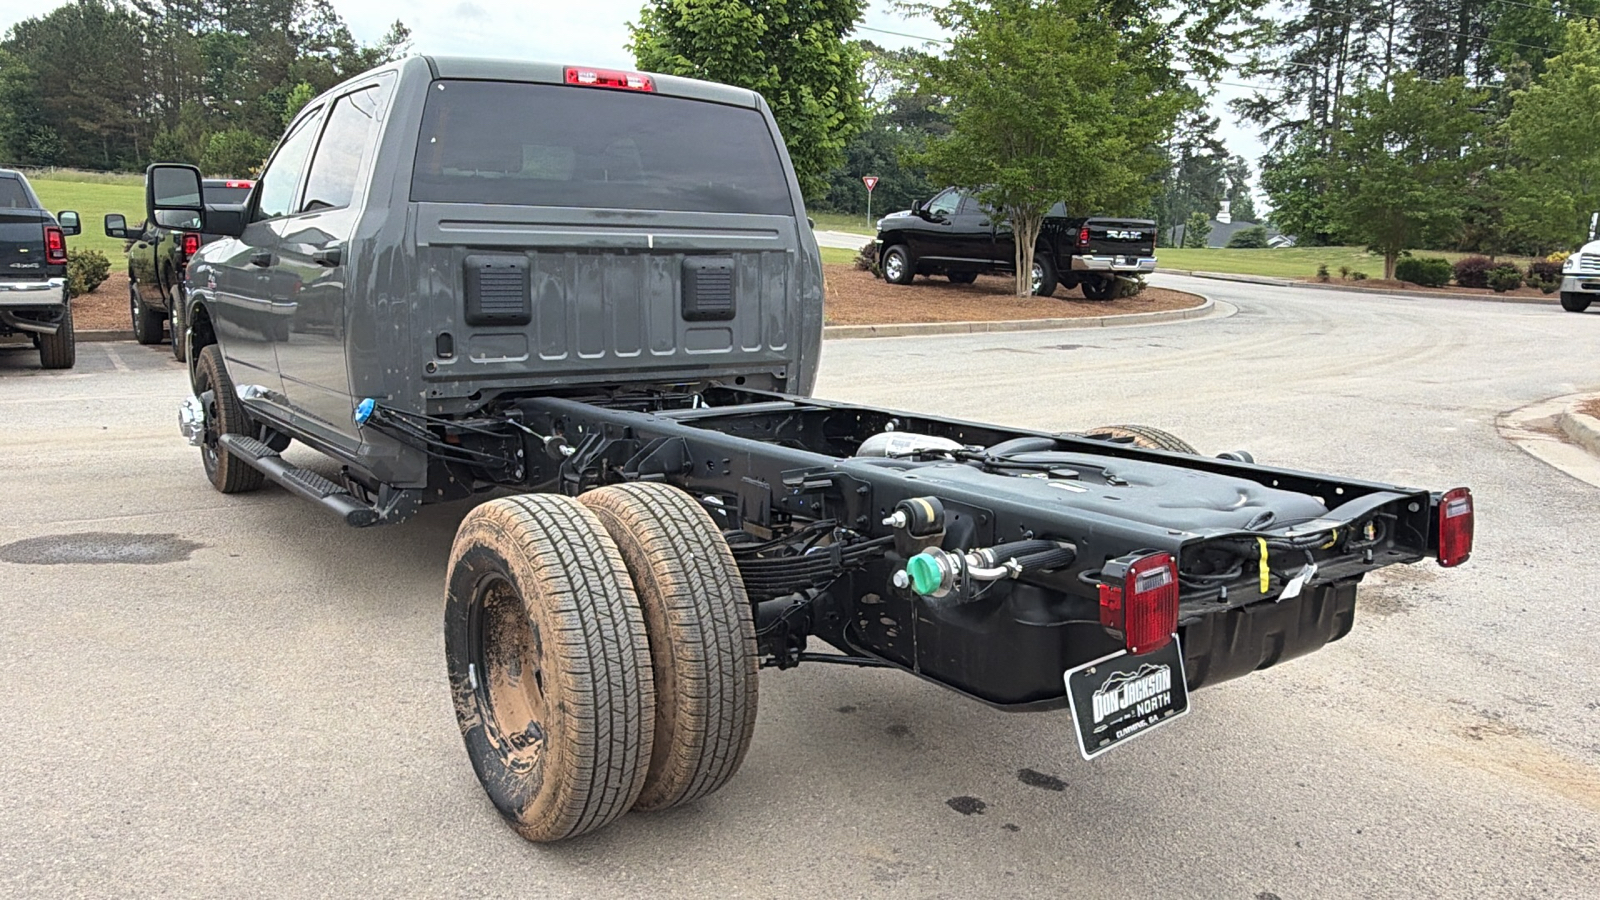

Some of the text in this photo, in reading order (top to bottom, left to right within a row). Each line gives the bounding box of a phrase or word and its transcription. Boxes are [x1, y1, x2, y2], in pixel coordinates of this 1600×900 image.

[1092, 689, 1119, 724] DON
[1120, 667, 1171, 709] JACKSON
[1136, 691, 1171, 717] NORTH
